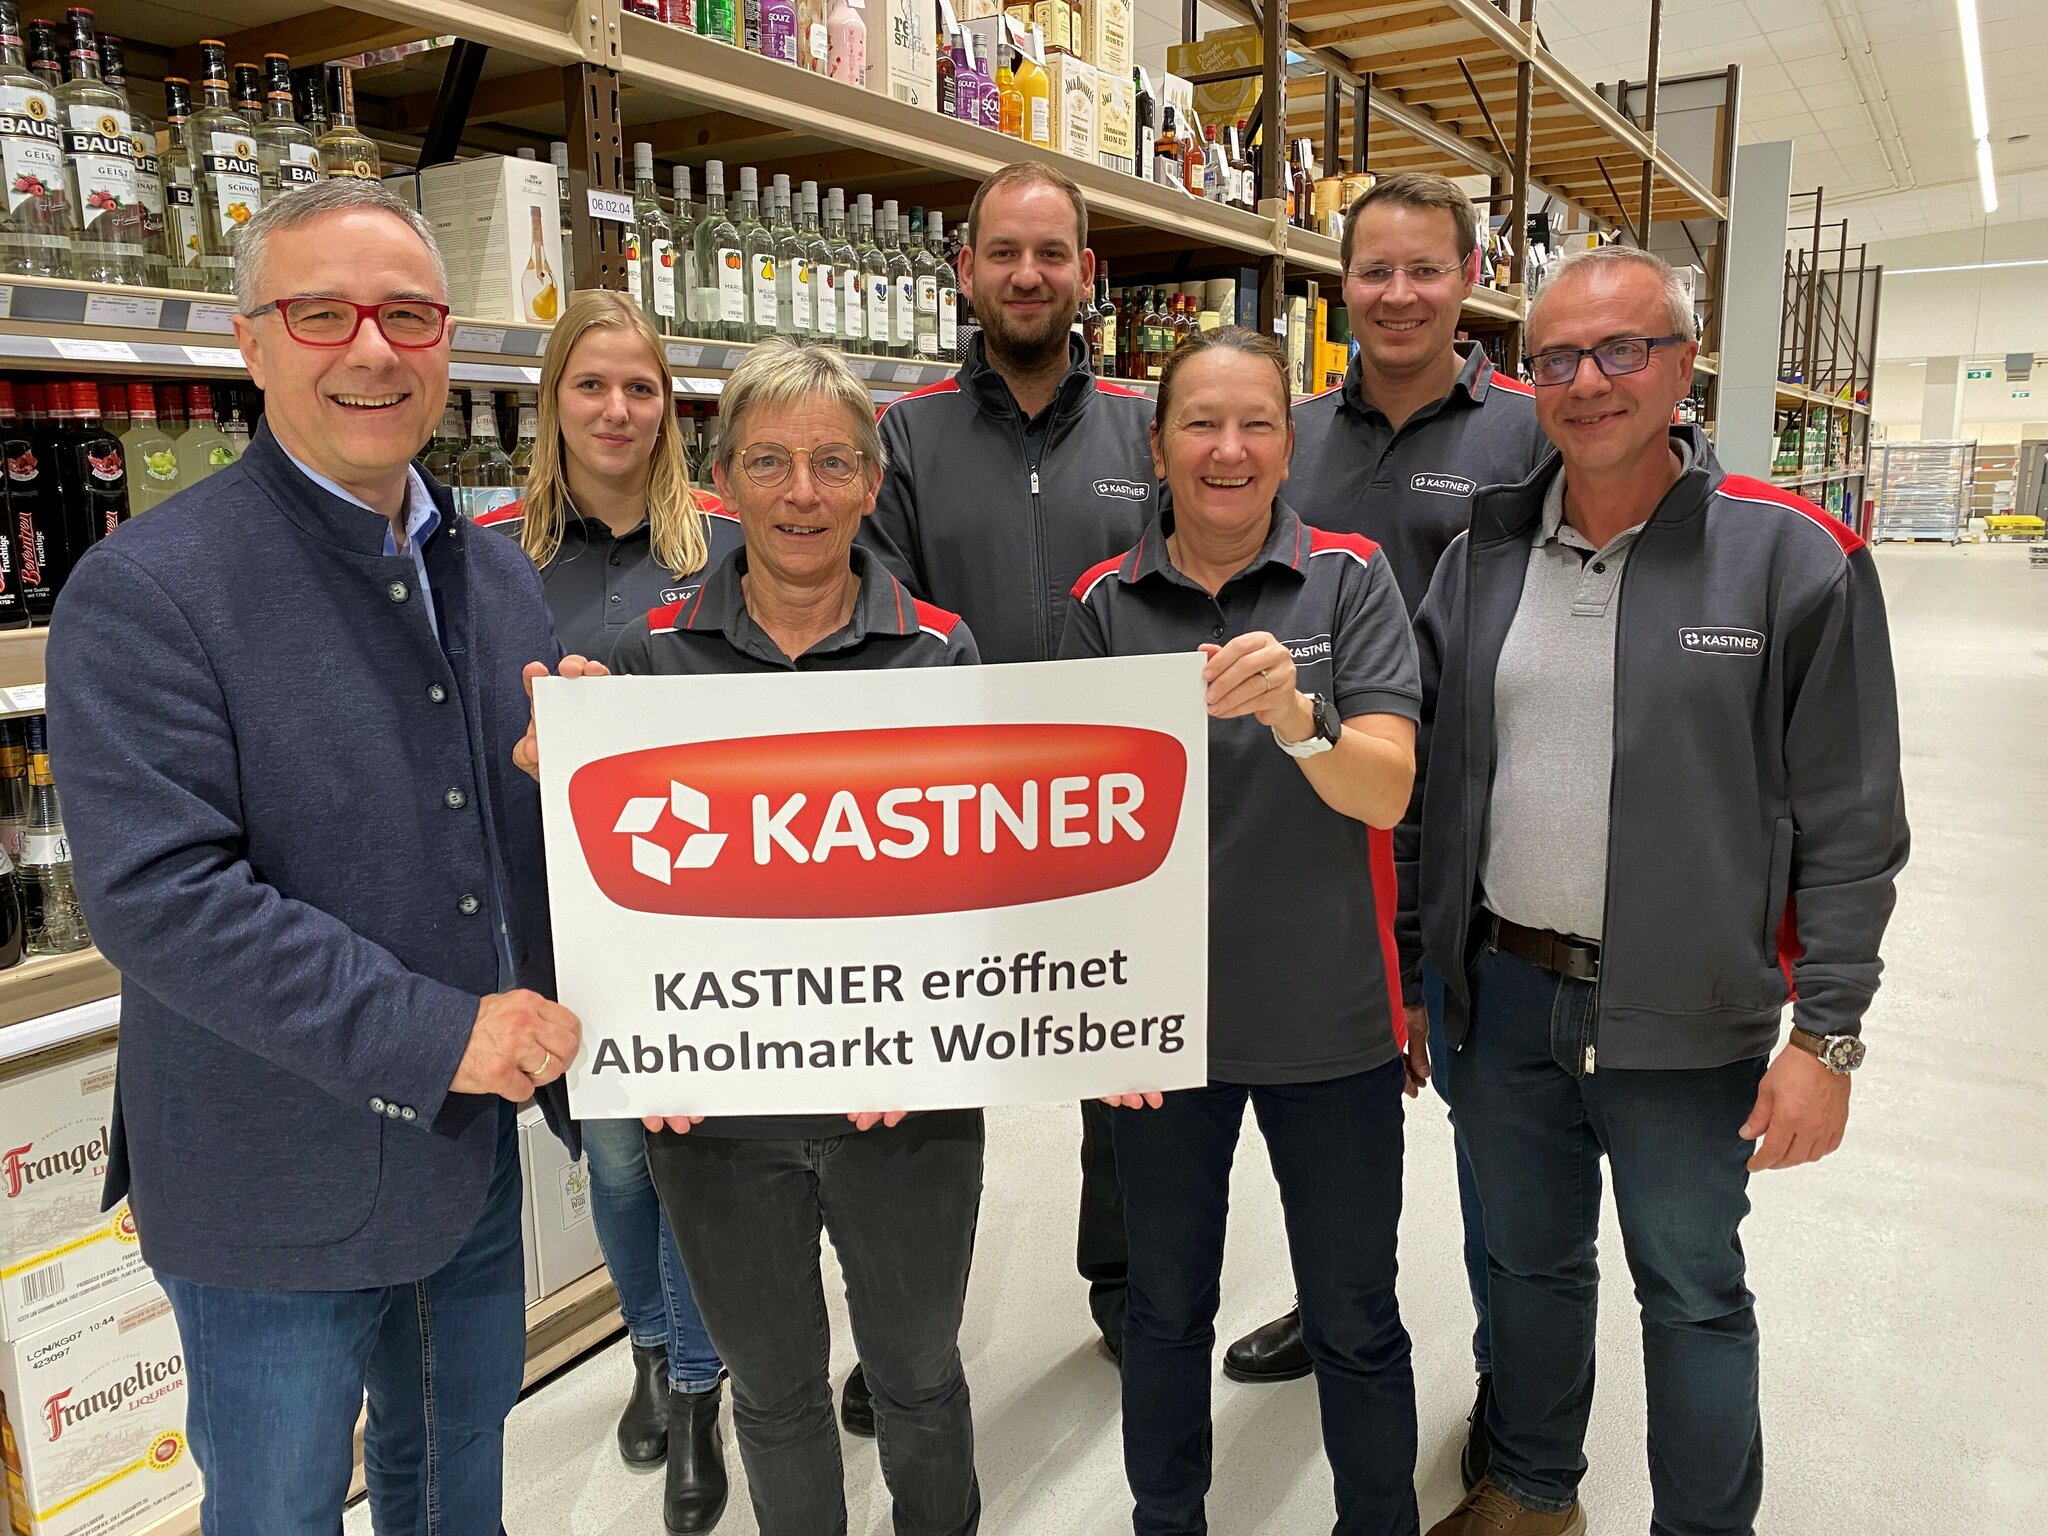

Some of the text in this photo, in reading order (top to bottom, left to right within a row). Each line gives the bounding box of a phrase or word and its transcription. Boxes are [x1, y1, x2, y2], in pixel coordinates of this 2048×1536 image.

[768, 13, 791, 23] sourz
[1105, 36, 1124, 47] HONEY
[1196, 40, 1222, 65] Dimple
[1200, 50, 1225, 71] Golden
[1205, 54, 1232, 74] lection
[1065, 79, 1077, 94] JACK
[1070, 131, 1089, 142] HONEY
[1103, 133, 1128, 147] HONEY
[25, 150, 56, 162] GEIST
[98, 166, 129, 177] GEIST
[291, 167, 320, 183] BAU
[592, 198, 632, 216] 06.02.04
[1109, 484, 1145, 496] KASTNER
[1426, 479, 1470, 492] KASTNER
[1, 535, 11, 573] Fruchtige
[19, 511, 42, 586] Berentzen
[37, 531, 46, 567] Fruchtige
[1289, 642, 1331, 657] KASTNE
[1702, 634, 1759, 649] KASTNER
[751, 772, 1147, 865] KASTNER
[654, 948, 1129, 1012] KASTNER eröffnet
[591, 1012, 1186, 1076] Abholmarkt Wolfsberg
[1, 1125, 110, 1198] Frangel
[115, 1231, 137, 1242] HAZEL
[26, 1315, 115, 1362] LCN/KG07 10:44
[32, 1347, 71, 1370] 423097
[43, 1354, 182, 1442] Frangelico
[127, 1379, 184, 1412] LIQUEUR
